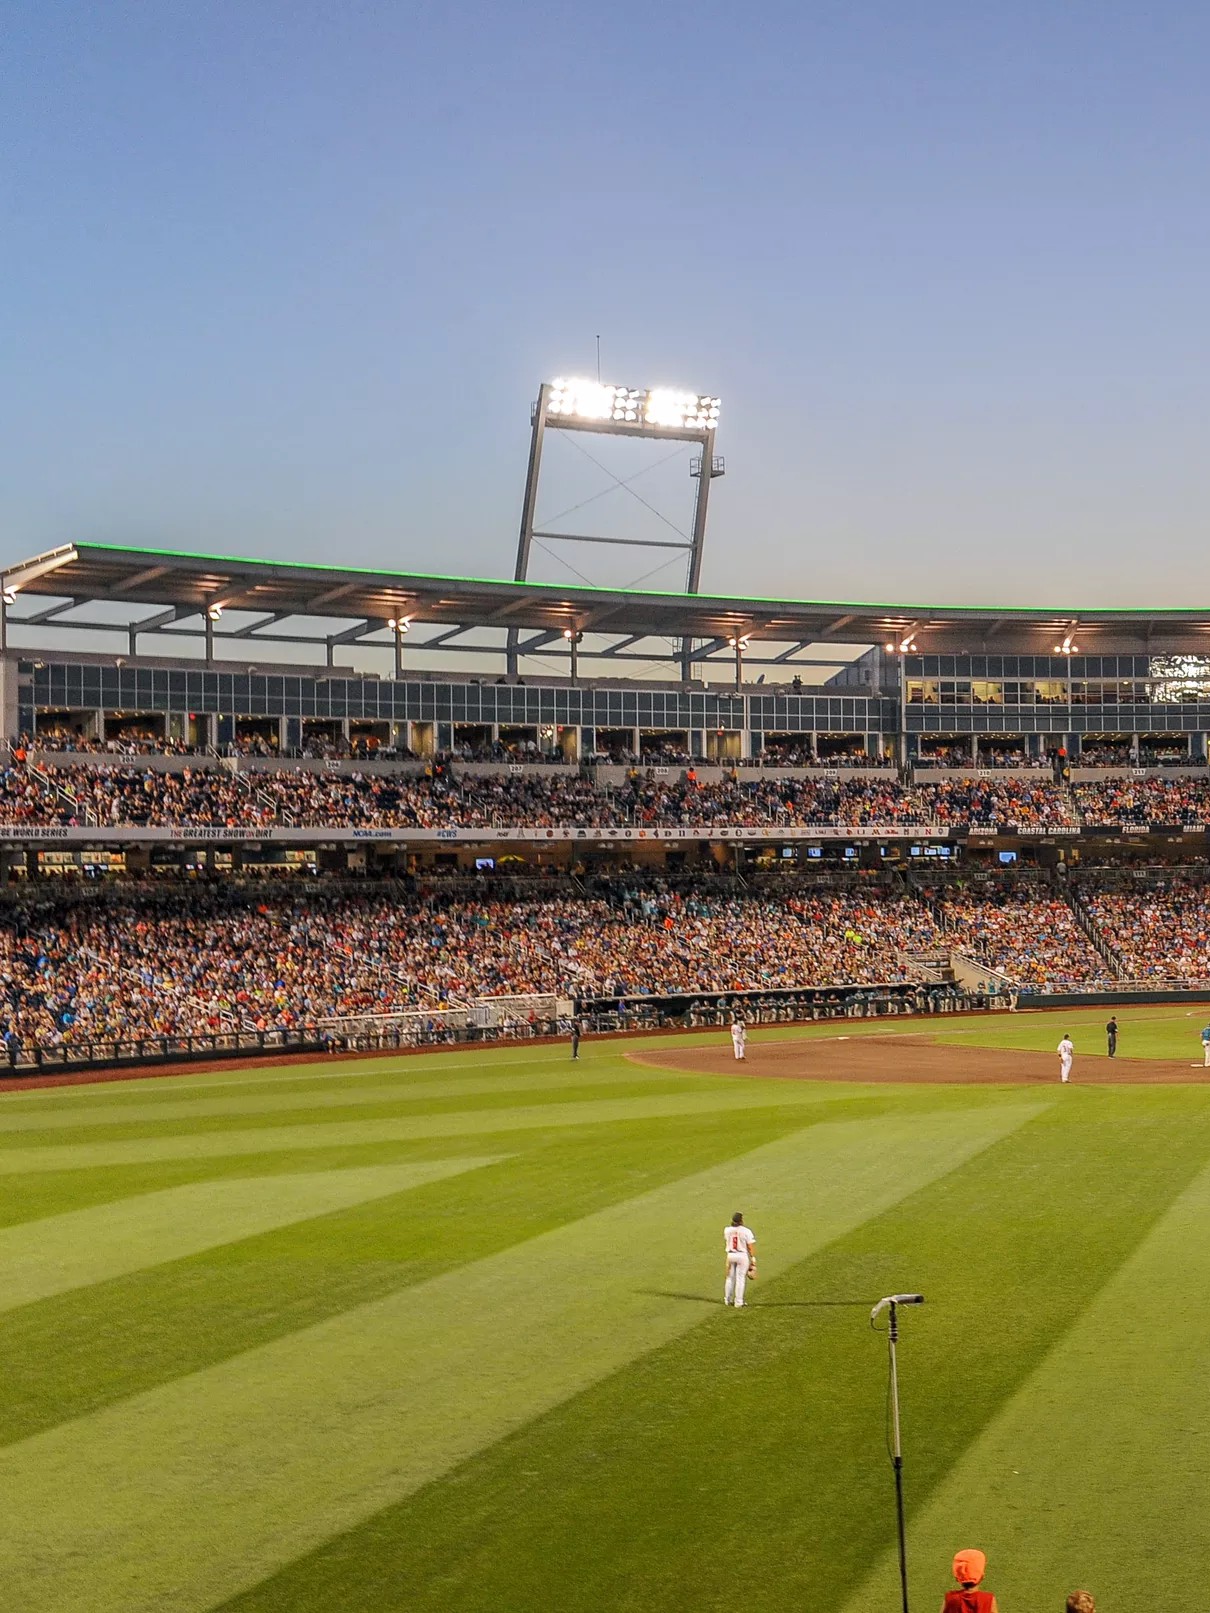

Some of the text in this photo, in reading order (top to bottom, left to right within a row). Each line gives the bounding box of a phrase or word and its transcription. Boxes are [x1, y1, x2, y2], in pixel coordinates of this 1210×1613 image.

[13, 828, 40, 837] WORLD
[41, 828, 68, 837] SERIES
[968, 827, 998, 835] ARIZONA
[1017, 827, 1081, 835] COASTAL CAROLINA
[1122, 825, 1150, 834] FLORIDA
[1183, 825, 1205, 833] MIAMI
[183, 829, 221, 838] GREATEST
[222, 829, 246, 838] SHOW
[255, 829, 273, 838] DIRT
[352, 830, 392, 838] NCAA.com
